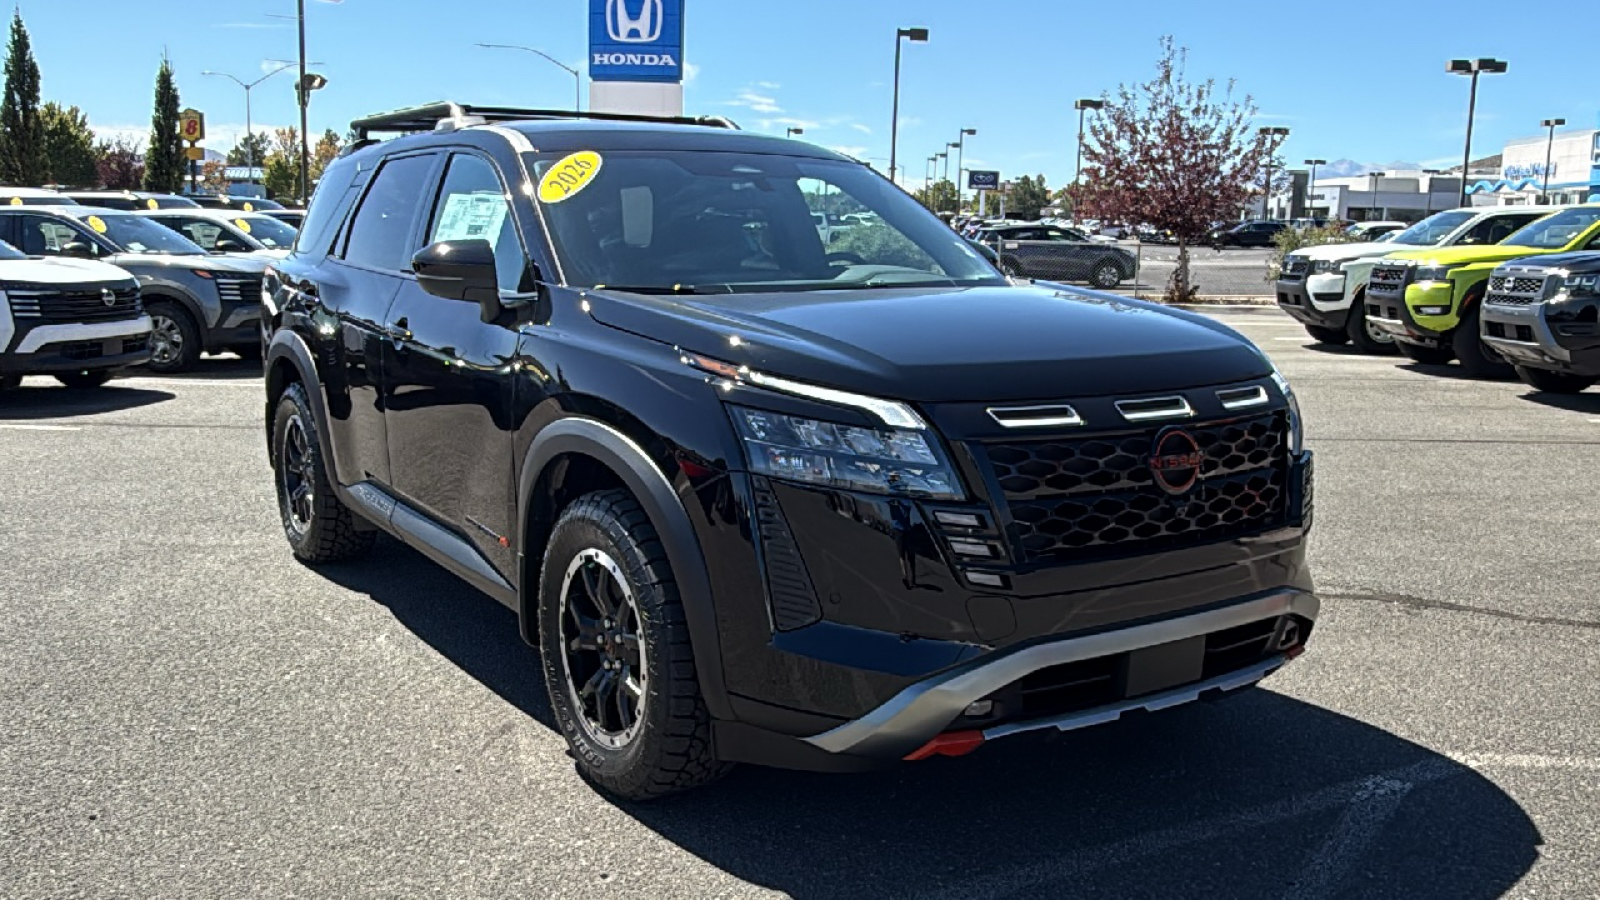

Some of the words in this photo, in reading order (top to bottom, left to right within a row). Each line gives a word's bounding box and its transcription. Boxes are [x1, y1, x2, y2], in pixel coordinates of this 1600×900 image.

[593, 53, 677, 66] HONDA
[185, 119, 198, 135] 8
[549, 157, 592, 194] 2026
